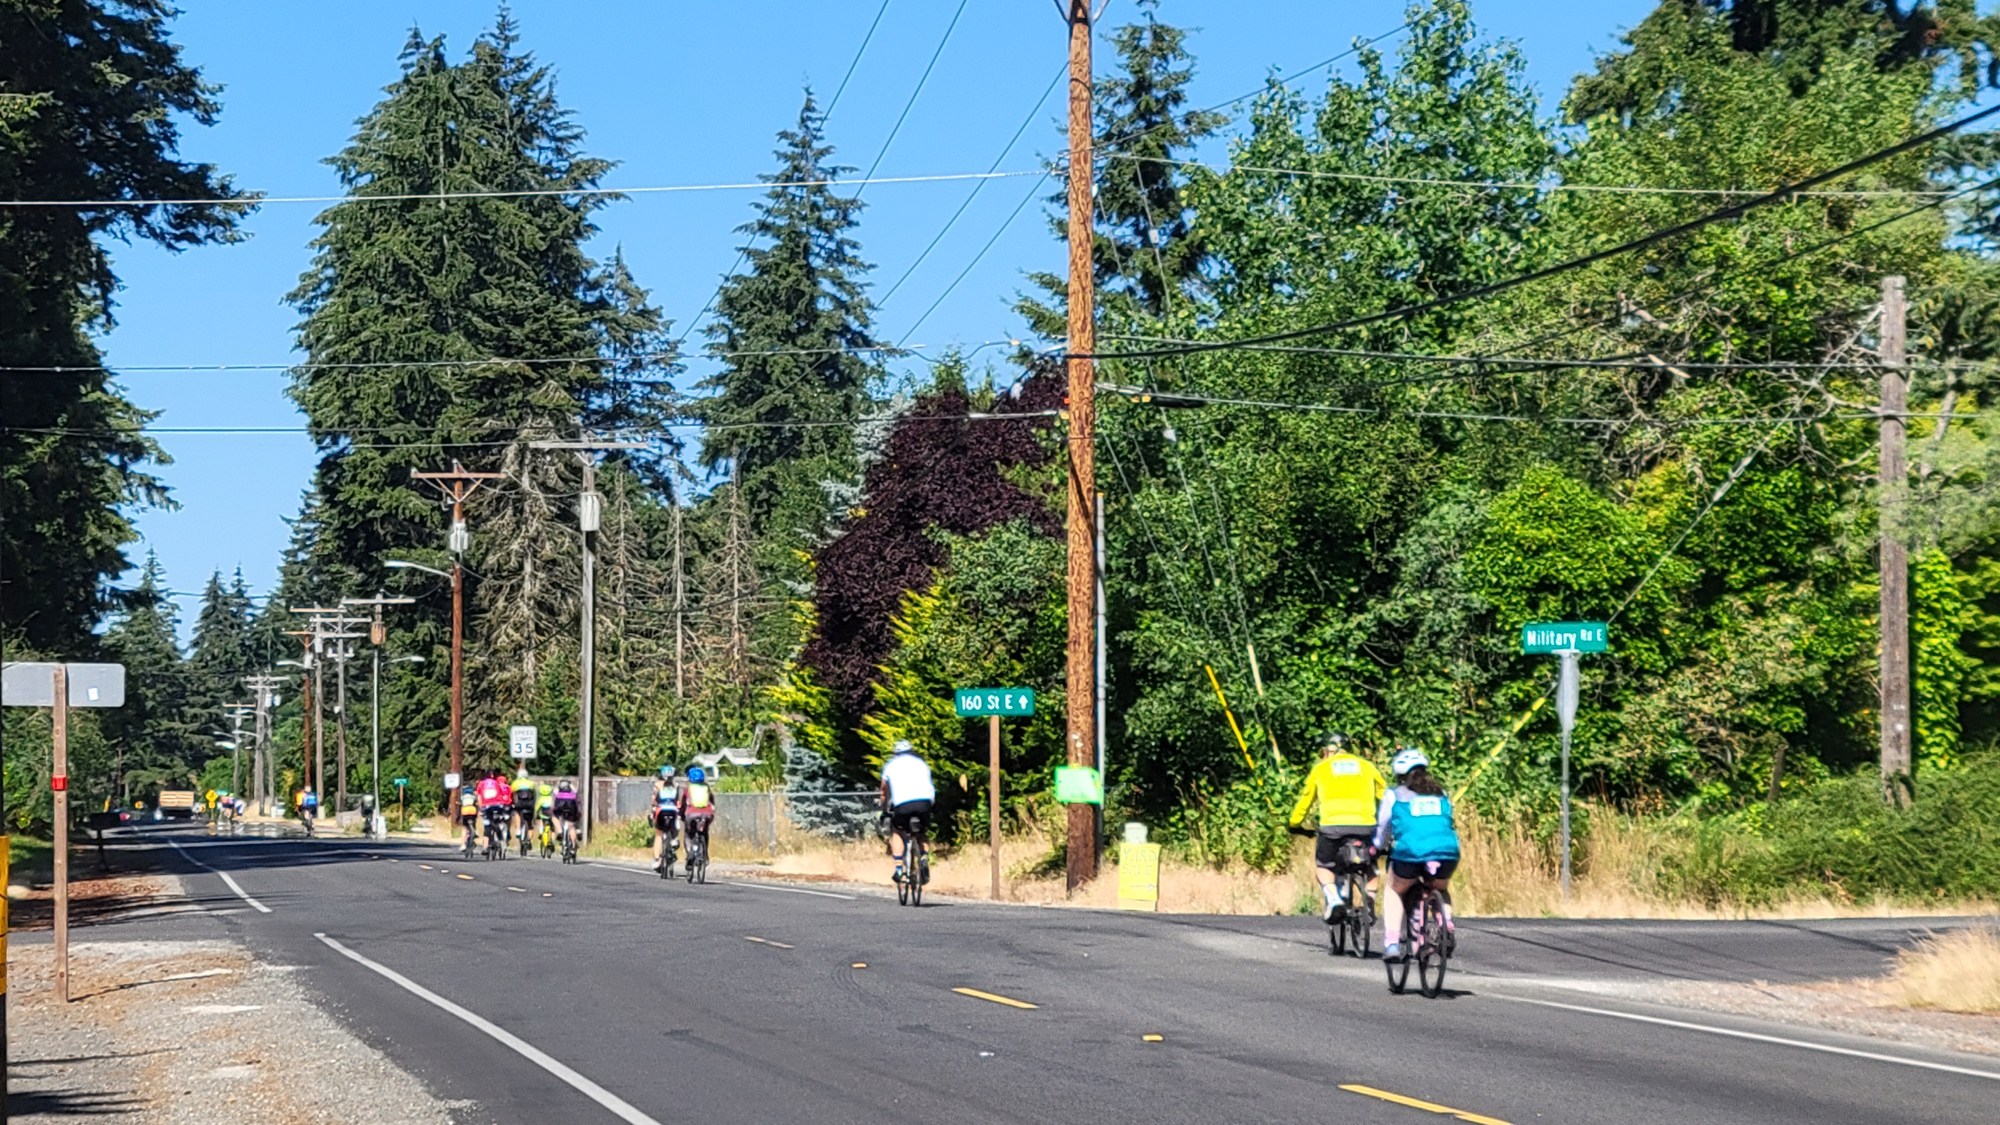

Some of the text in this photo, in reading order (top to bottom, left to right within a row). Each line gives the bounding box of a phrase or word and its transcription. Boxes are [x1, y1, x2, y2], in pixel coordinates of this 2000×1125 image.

[1527, 630, 1576, 650] Military
[1596, 628, 1603, 641] E
[961, 694, 1013, 710] 160 St E
[514, 742, 534, 754] 35
